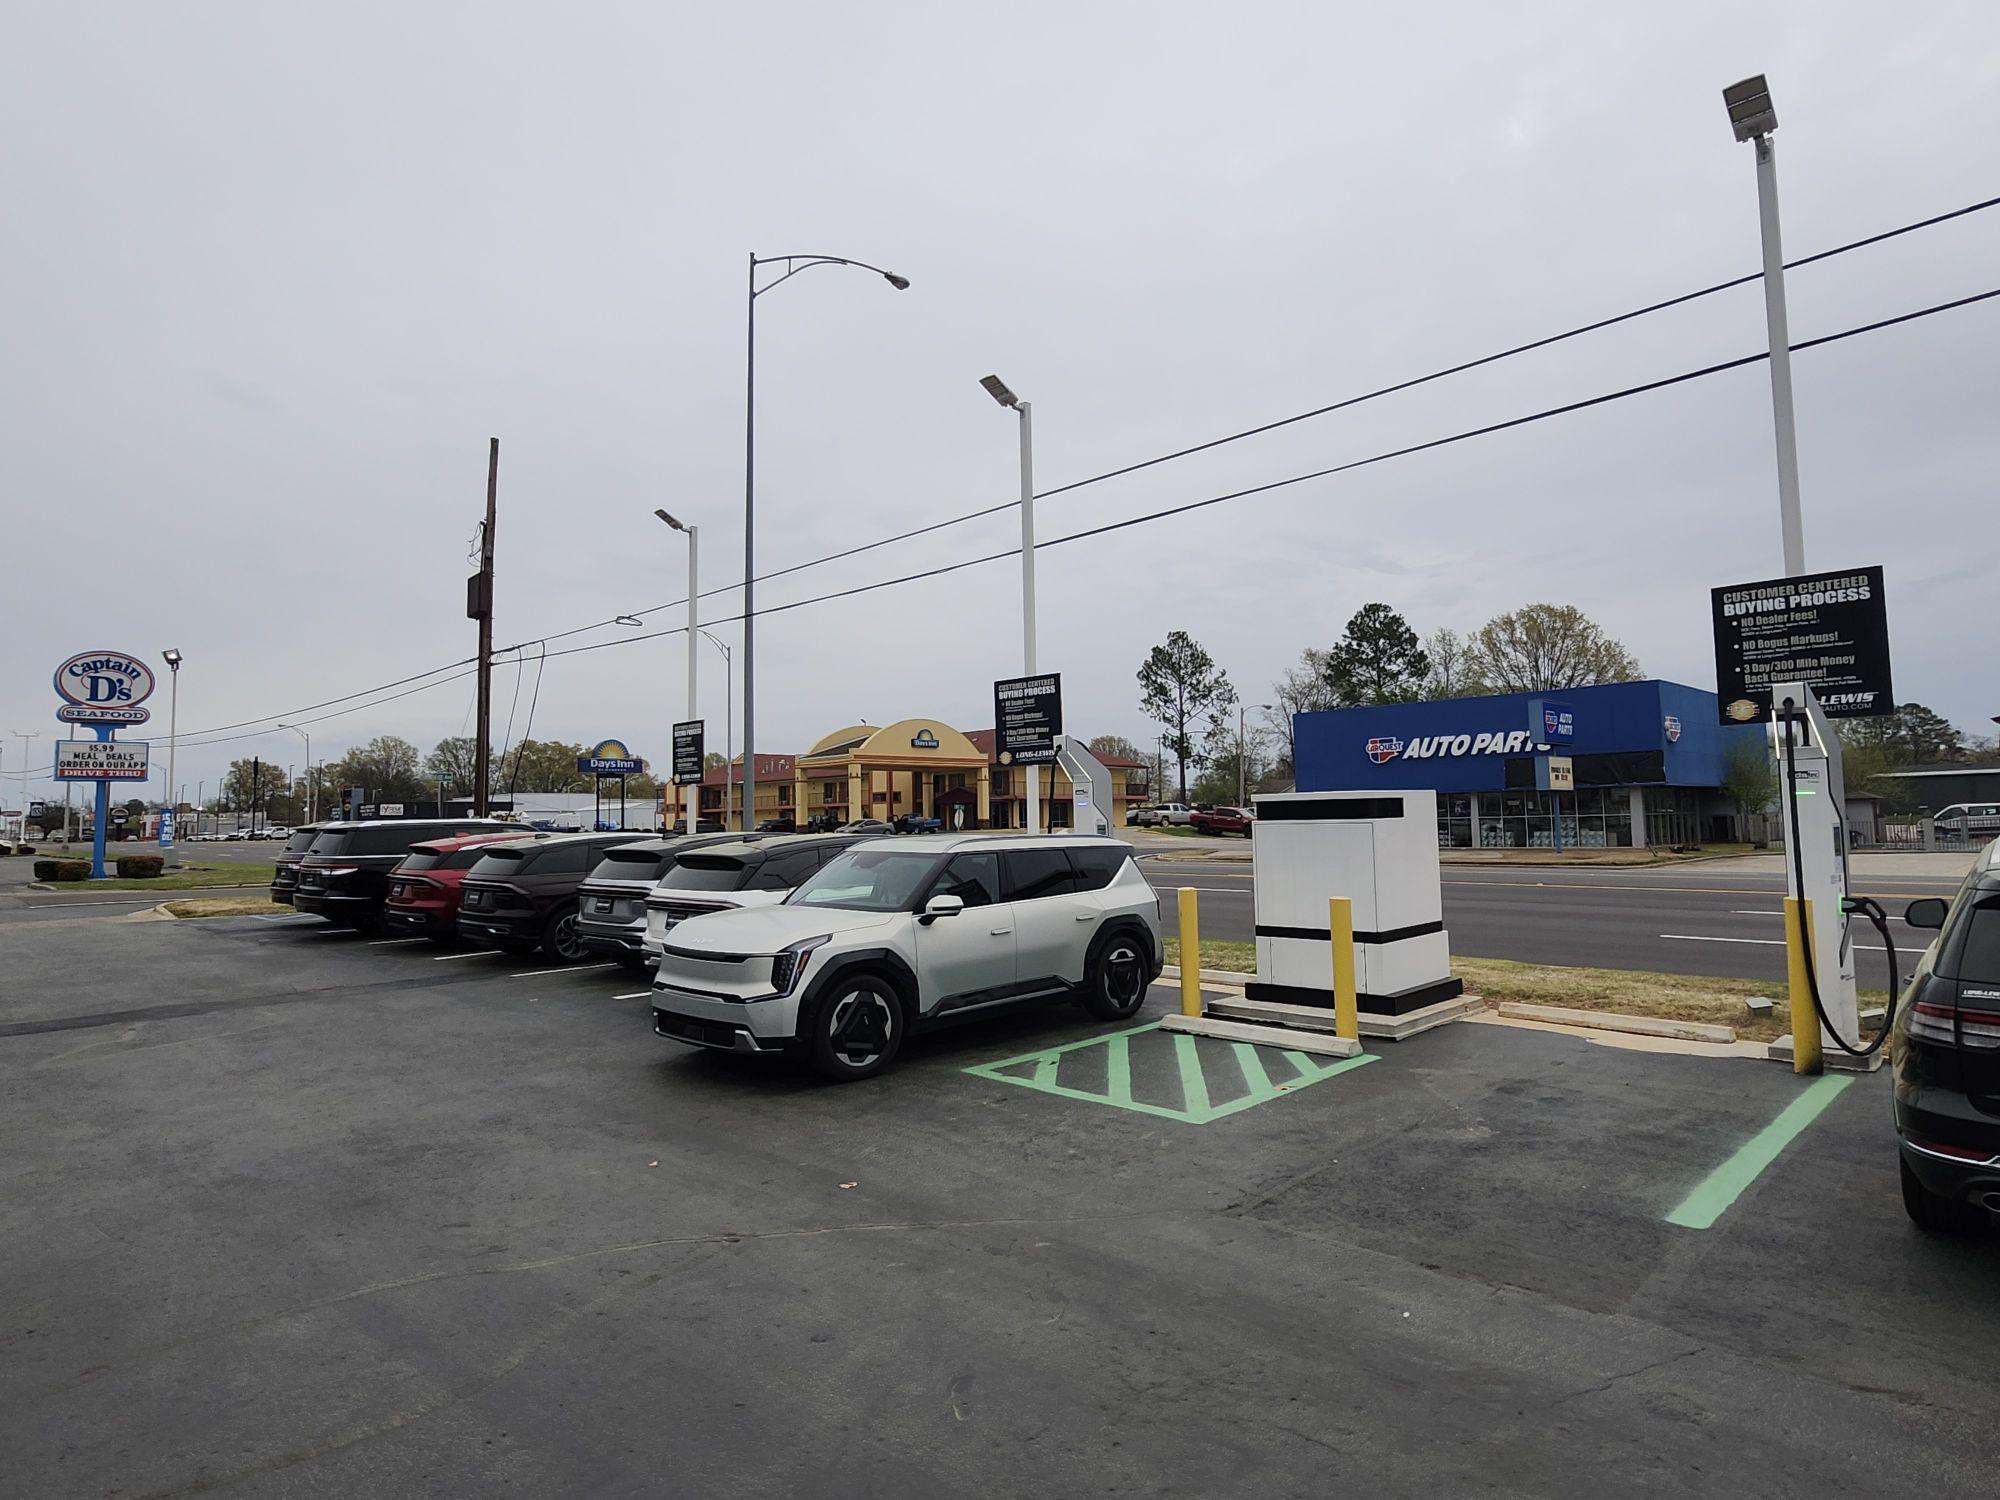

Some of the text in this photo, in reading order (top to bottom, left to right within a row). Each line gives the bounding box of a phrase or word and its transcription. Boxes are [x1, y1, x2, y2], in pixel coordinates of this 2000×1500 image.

[1723, 575, 1869, 603] CUSTOMER CENTERED
[1723, 586, 1871, 616] BUYING PROCESS
[1741, 618, 1754, 627] NO
[1756, 614, 1788, 626] Dealer
[1790, 610, 1817, 621] Fees!
[1743, 640, 1756, 650] NO
[1758, 638, 1788, 649] Bogus
[1790, 631, 1839, 645] Markups!
[69, 657, 141, 680] Captain
[1744, 655, 1855, 673] 3 Day/300 Mile Money
[1745, 674, 1769, 684] Back
[1771, 668, 1827, 681] Guarantee!
[86, 676, 132, 702] D's
[1024, 685, 1056, 697] PROCESS
[66, 709, 144, 719] SEAFOOD
[1560, 713, 1573, 724] AUTO
[1558, 724, 1573, 736] PARTS
[89, 744, 114, 752] $5.99
[1402, 734, 1471, 759] AUTO
[106, 753, 135, 761] DEALS
[590, 759, 634, 768] Days Inn
[106, 761, 126, 769] OUR
[63, 769, 141, 777] DRIVE THRU
